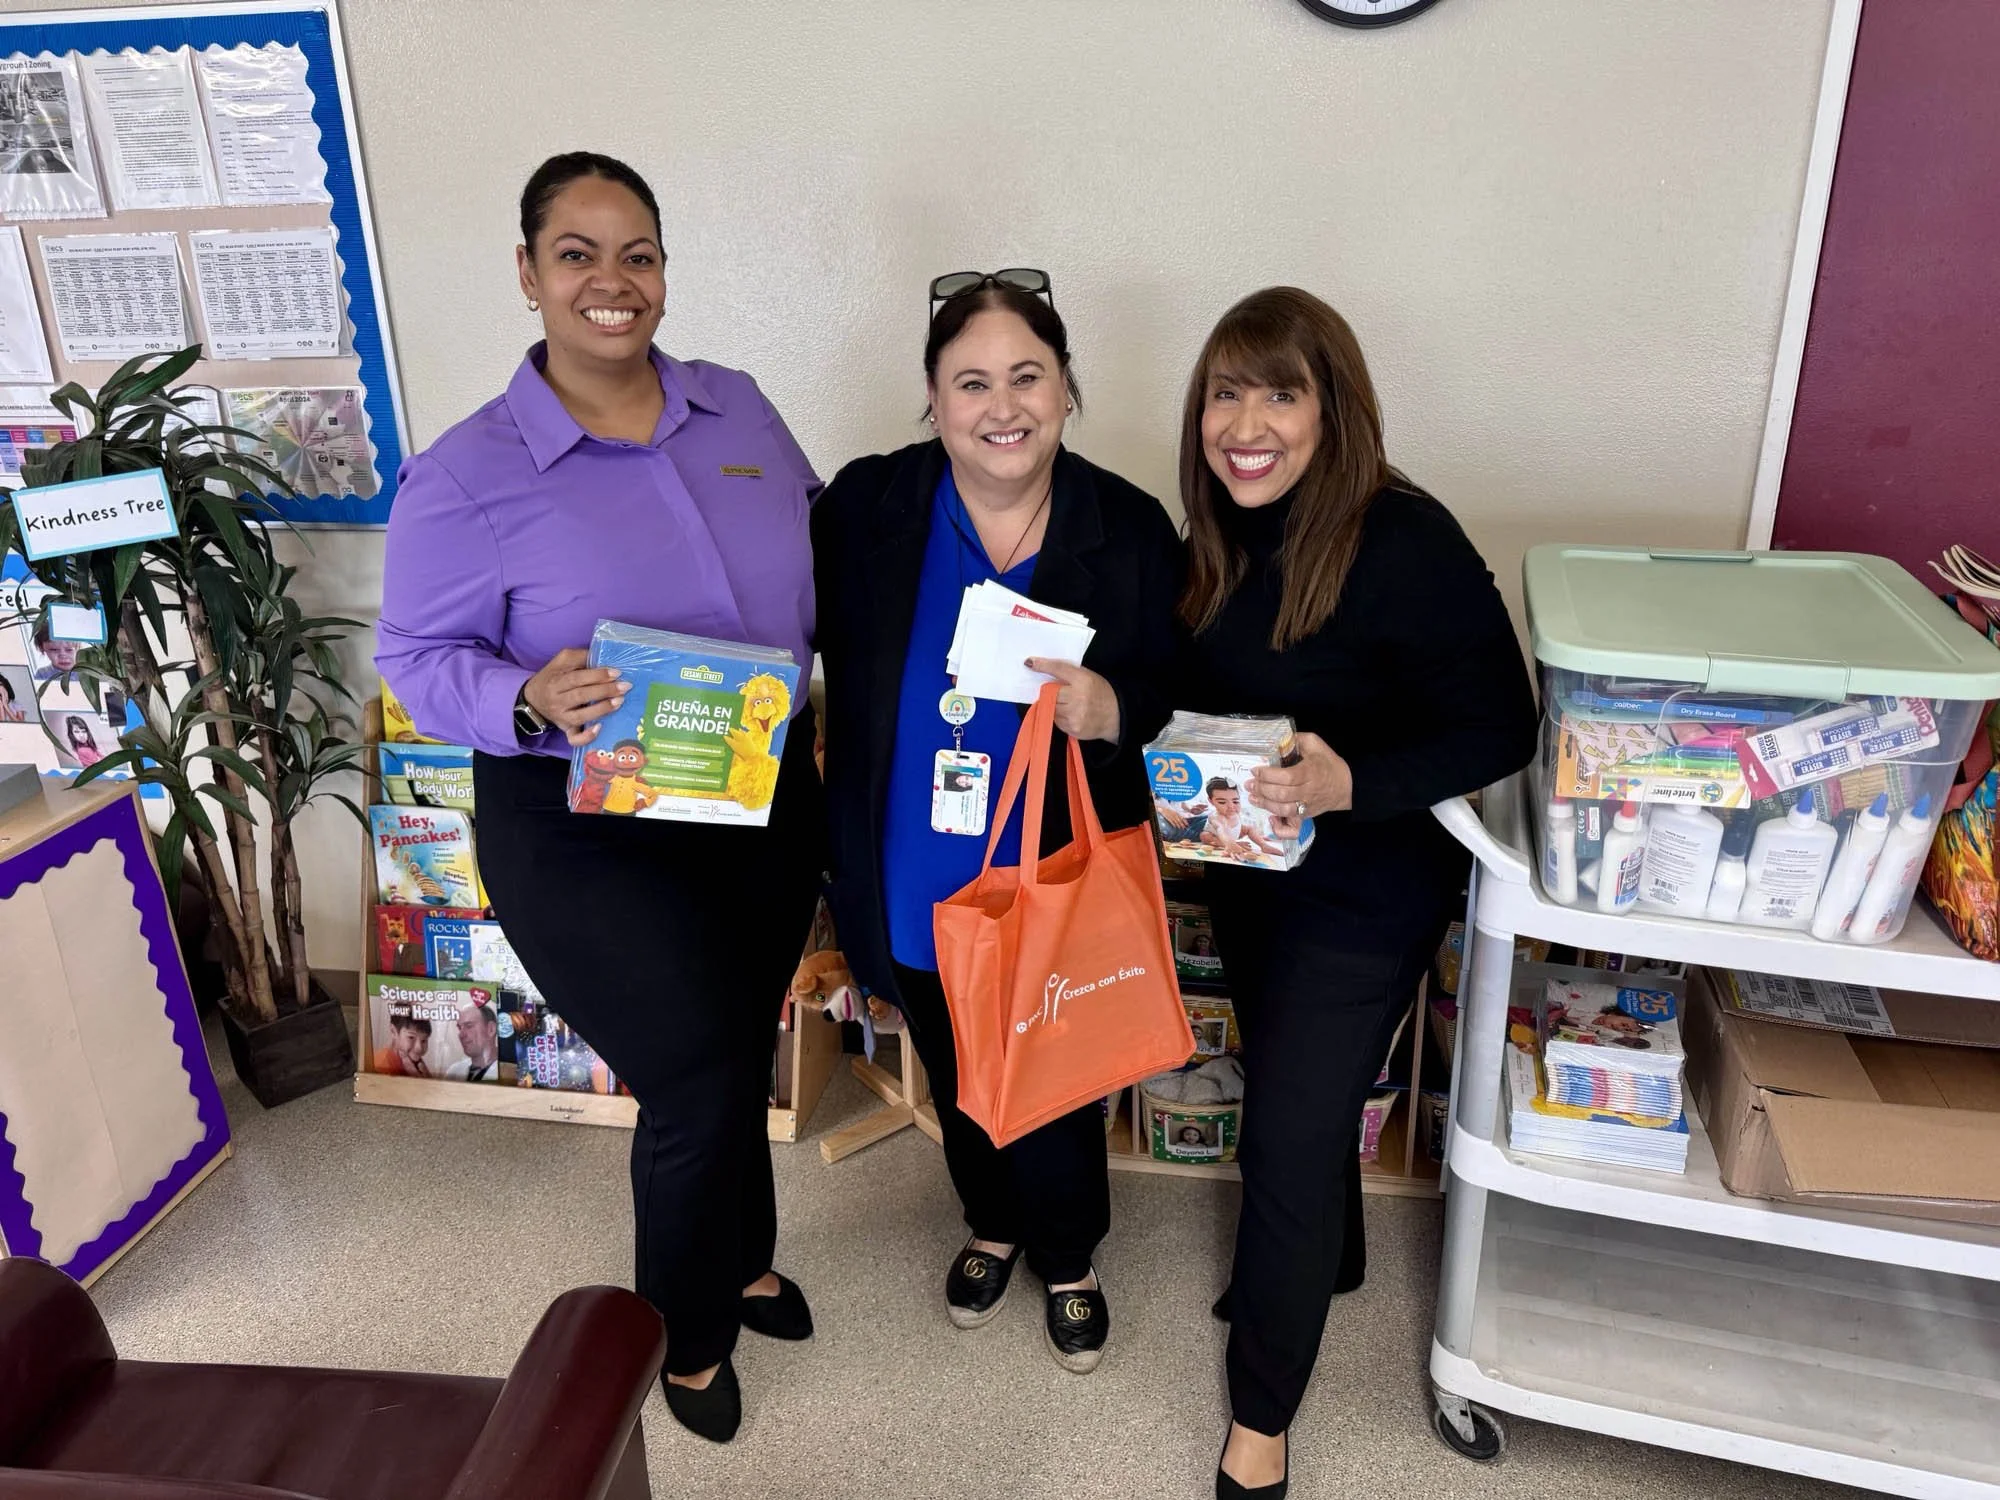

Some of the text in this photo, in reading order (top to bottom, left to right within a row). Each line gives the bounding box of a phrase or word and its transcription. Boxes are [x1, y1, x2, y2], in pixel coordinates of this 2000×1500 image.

[25, 499, 166, 532] Kindness Tree
[683, 670, 720, 681] SESAME STREET
[657, 699, 733, 719] ¡SUEÑA EN
[1681, 707, 1694, 716] Dry
[1695, 709, 1713, 717] Erase
[1715, 711, 1737, 719] Board
[654, 713, 730, 735] GRANDE!
[1764, 733, 1778, 759] ERASER
[404, 762, 434, 780] How
[1152, 757, 1189, 783] 25
[415, 781, 443, 797] Body
[1673, 788, 1696, 800] brite
[398, 815, 436, 830] Hey,
[378, 828, 462, 848] Pancakes!
[380, 984, 434, 1001] Science
[436, 991, 457, 1001] and
[1063, 983, 1096, 1000] Crezca
[1098, 974, 1116, 988] con
[1118, 966, 1146, 981] Éxito
[412, 1004, 460, 1020] Health
[1638, 991, 1668, 1016] 25
[528, 1047, 537, 1069] THE
[536, 1036, 548, 1082] SOLAR
[547, 1034, 559, 1086] SYSTEM
